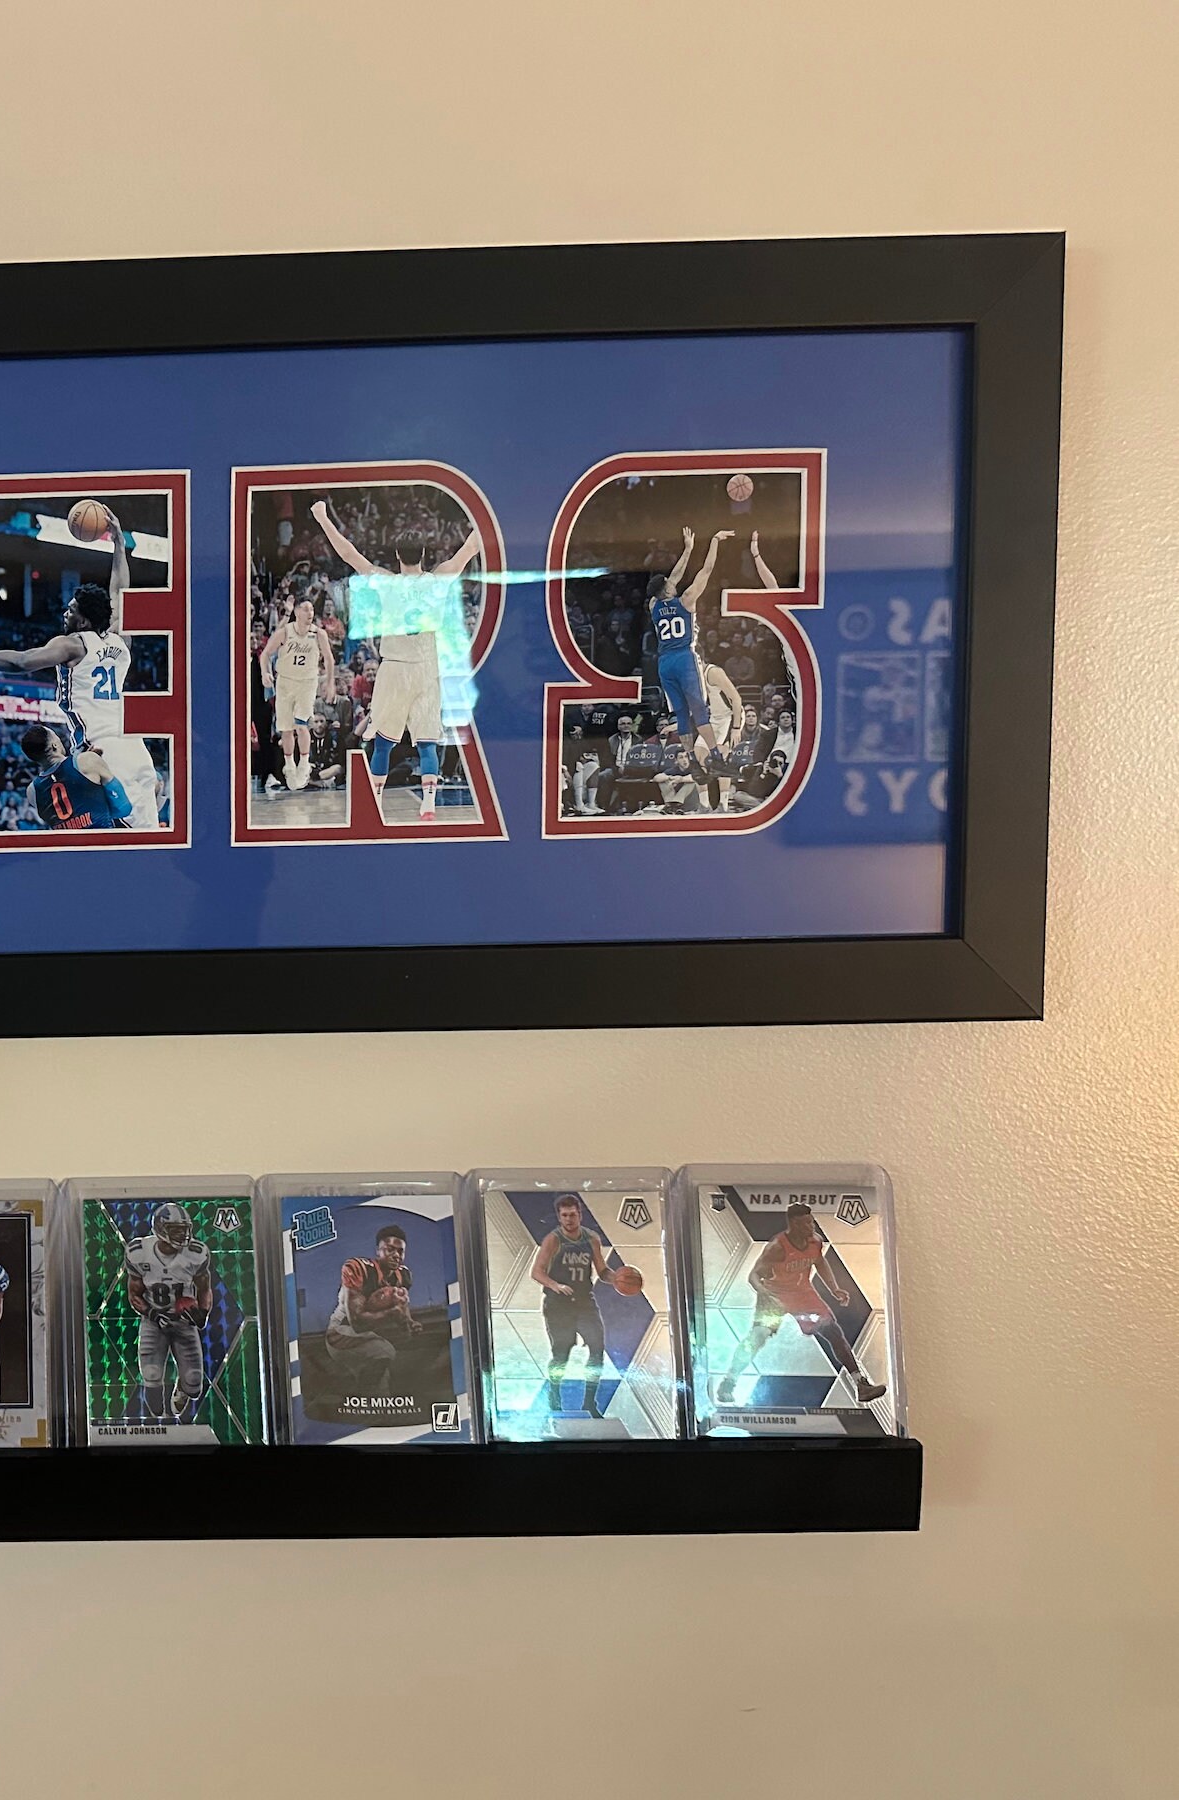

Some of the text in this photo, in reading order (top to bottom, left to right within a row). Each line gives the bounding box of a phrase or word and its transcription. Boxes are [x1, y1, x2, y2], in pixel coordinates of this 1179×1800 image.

[658, 617, 686, 640] 20
[293, 655, 306, 666] 12
[91, 665, 120, 700] 21
[51, 782, 73, 820] 0
[750, 1193, 837, 1206] NBA DEBUT
[296, 1208, 329, 1230] RATED
[294, 1221, 333, 1246] ROOKIE
[562, 1252, 591, 1265] MAVS
[568, 1267, 584, 1281] 77
[343, 1395, 415, 1408] JOE MIXON
[337, 1406, 422, 1415] CINCINNATI BENGALS
[720, 1415, 797, 1425] ZION WILLIAMSON
[98, 1427, 167, 1435] CALVIN JOHNSON
